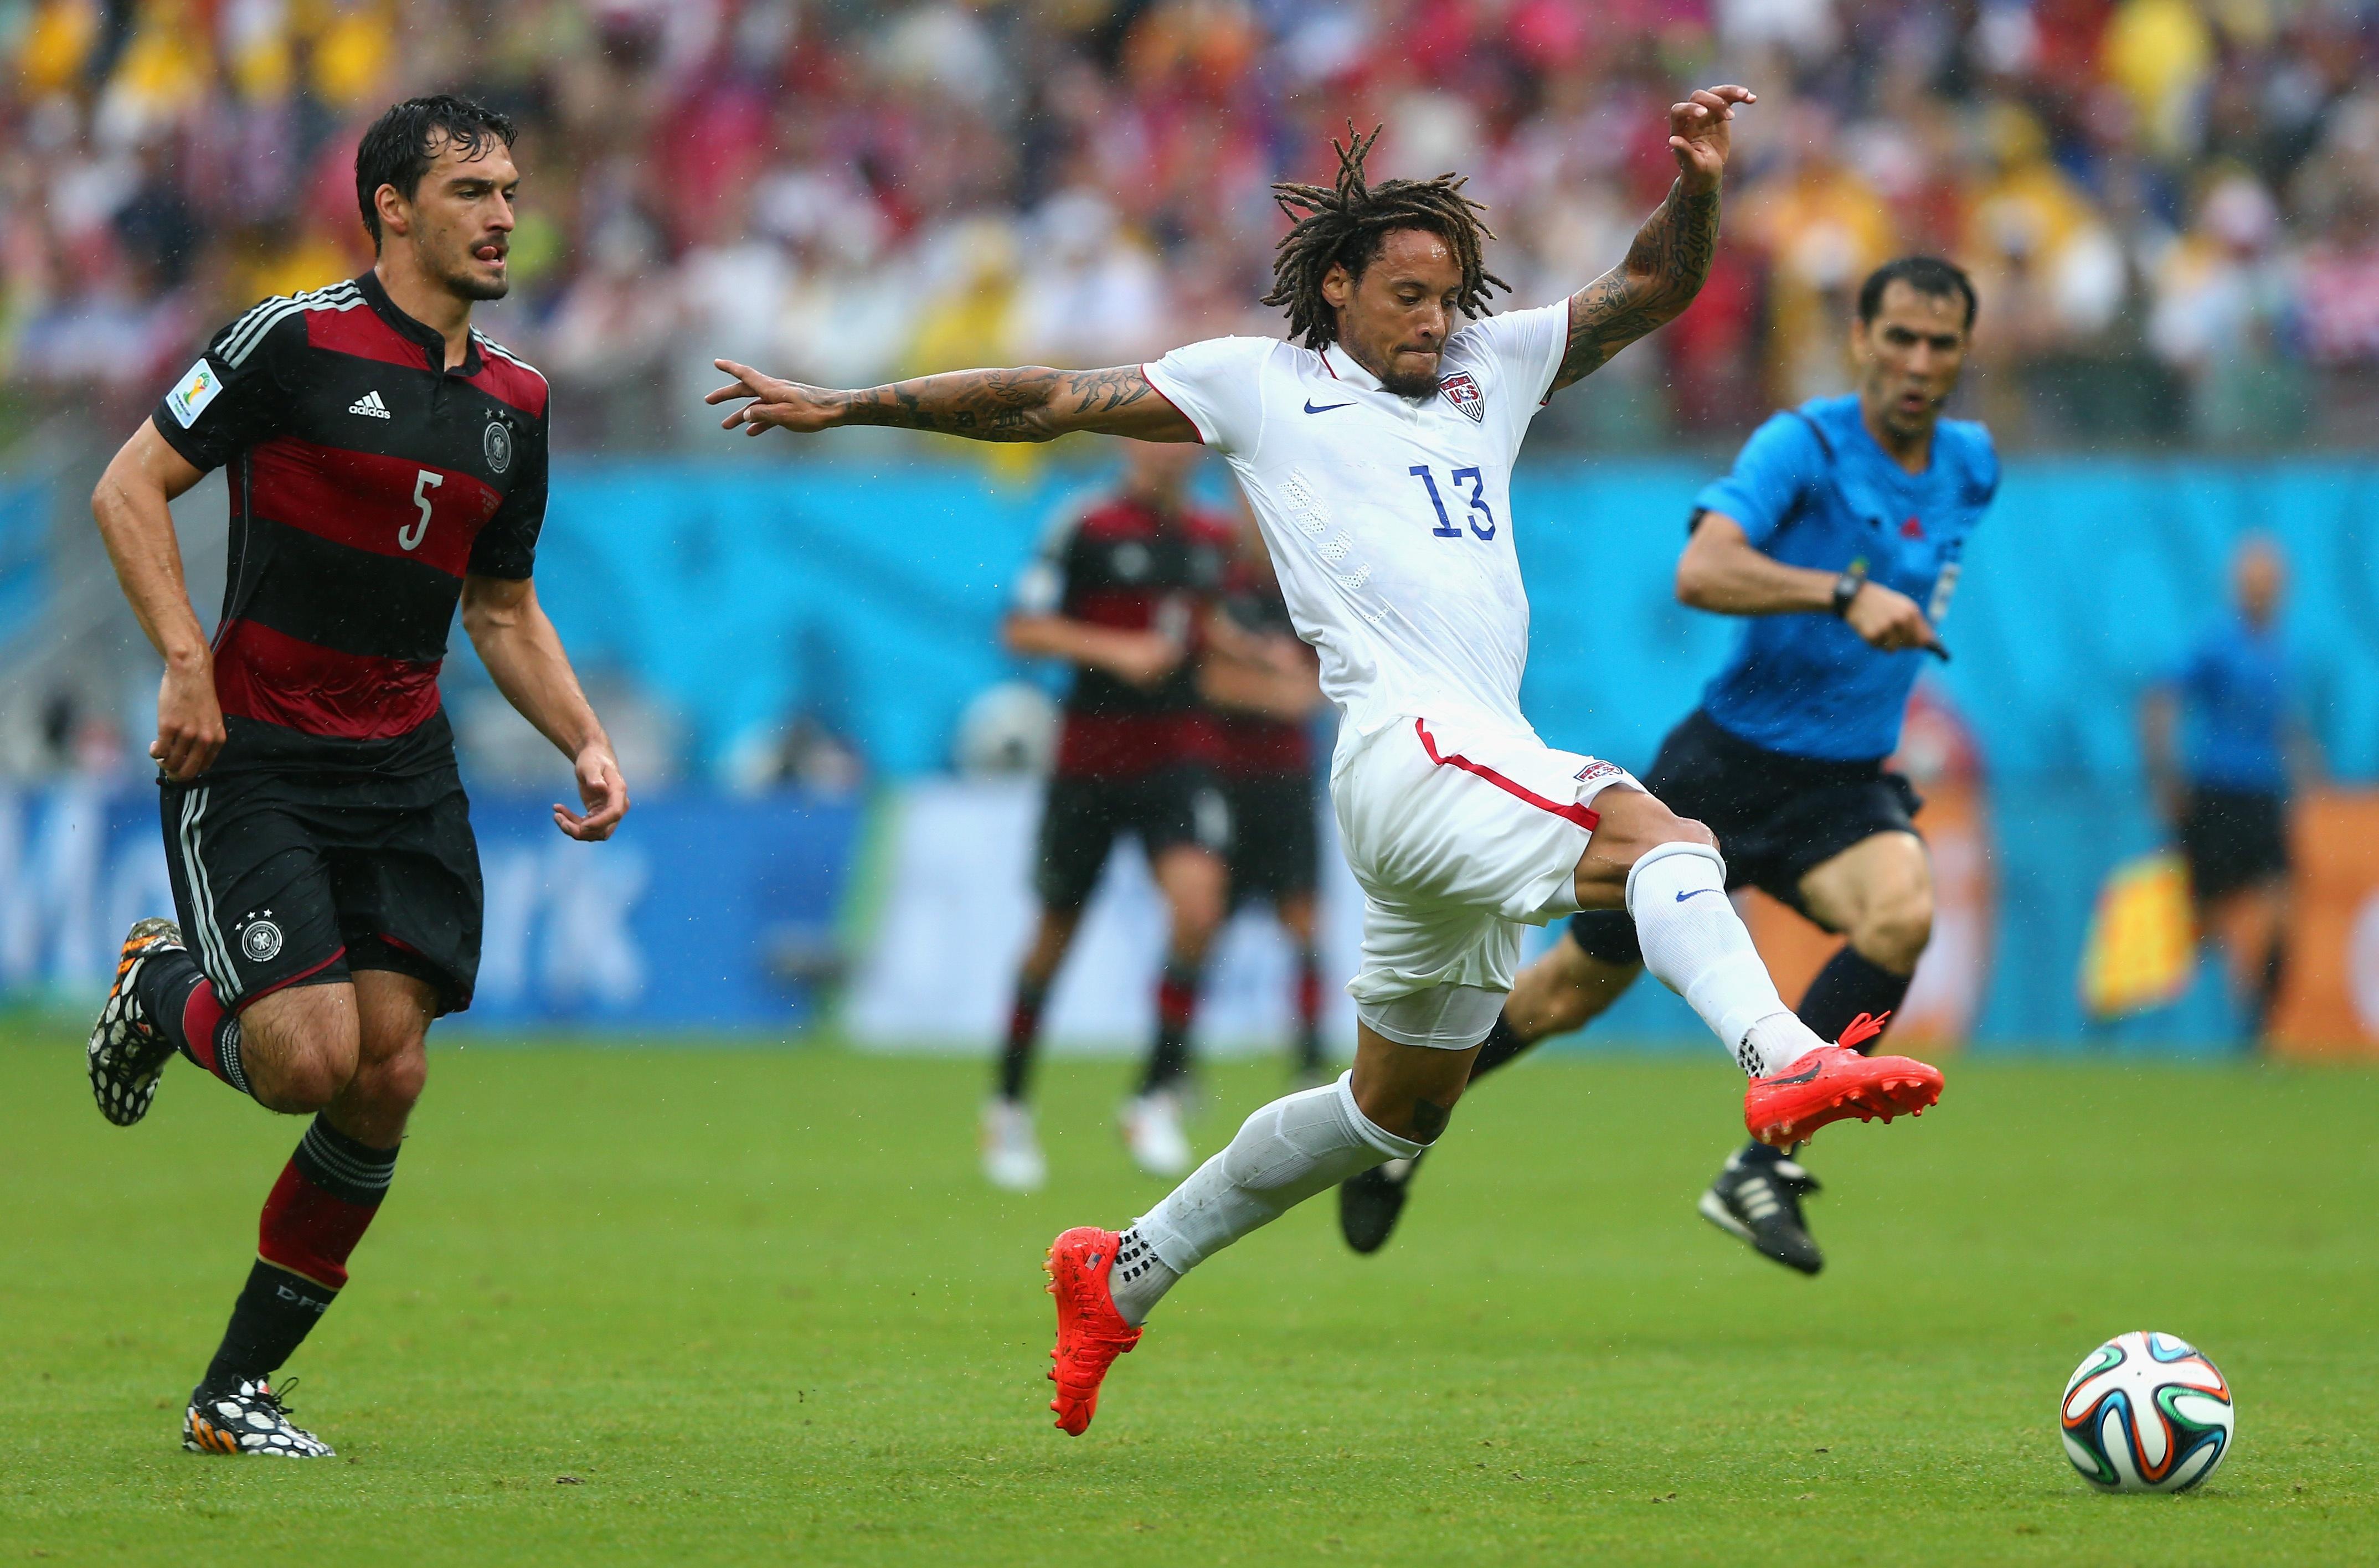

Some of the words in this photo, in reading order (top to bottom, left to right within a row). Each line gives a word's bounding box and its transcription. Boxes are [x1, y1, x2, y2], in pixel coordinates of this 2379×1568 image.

[348, 405, 391, 419] adidas
[398, 469, 444, 551] 5
[1408, 465, 1496, 541] 13
